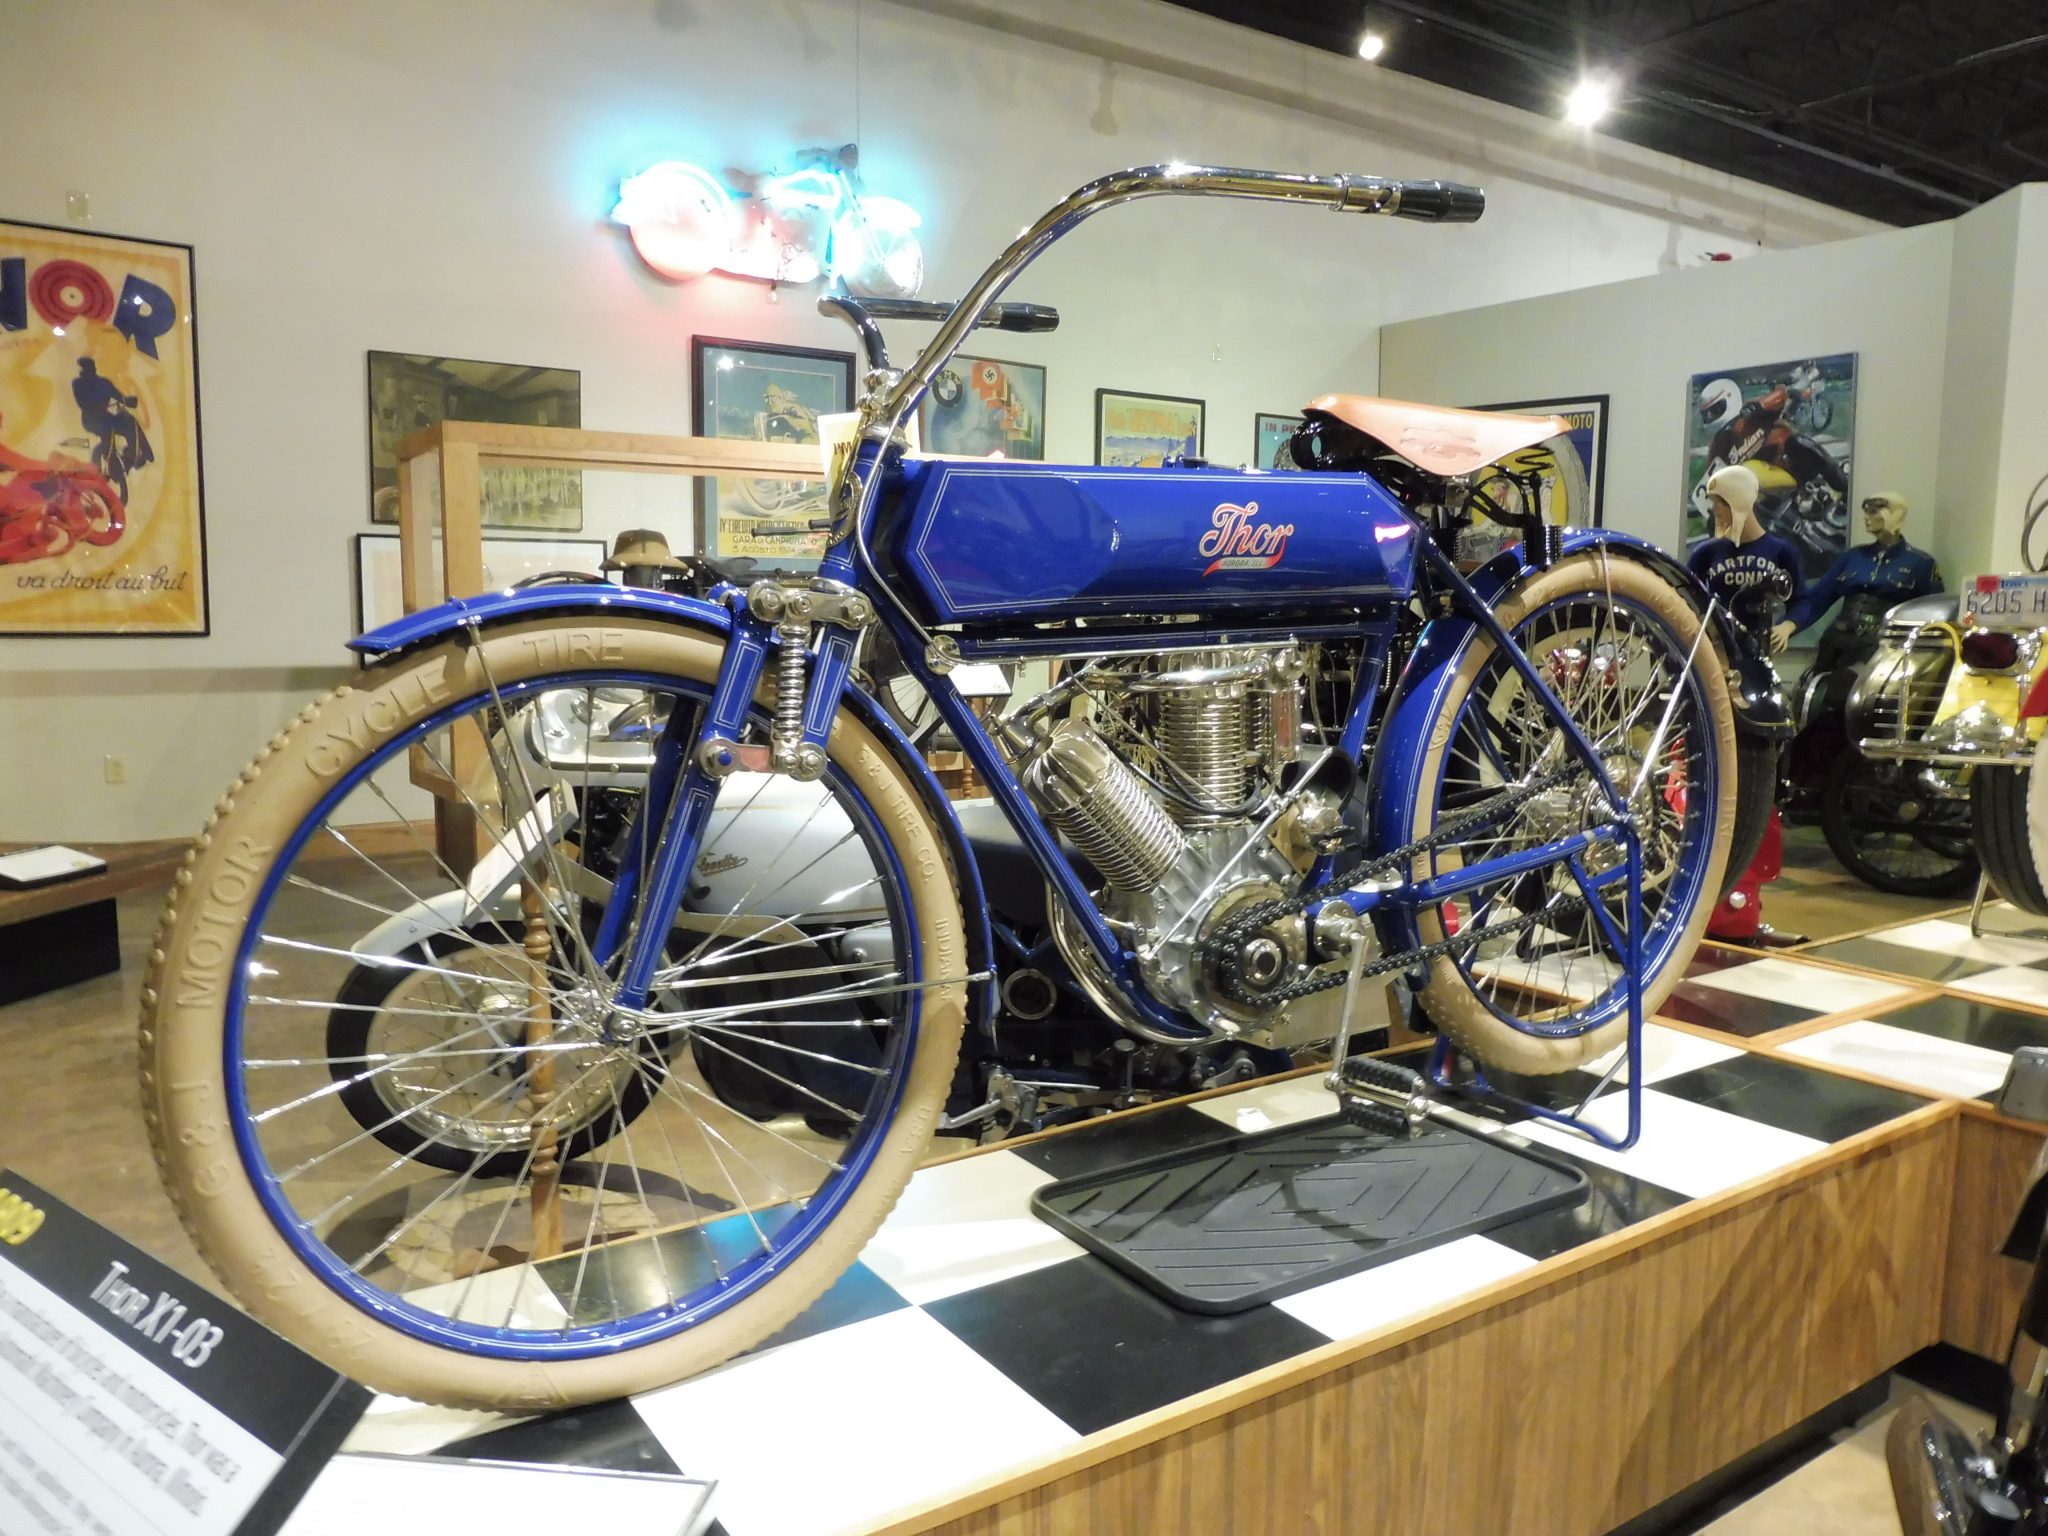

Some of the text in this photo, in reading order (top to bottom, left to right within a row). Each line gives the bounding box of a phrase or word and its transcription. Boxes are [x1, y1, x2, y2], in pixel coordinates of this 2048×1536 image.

[1728, 427, 1765, 465] Indian
[1199, 501, 1294, 558] Thor
[742, 545, 776, 554] AGOSTO
[17, 564, 188, 591] va droit au but
[177, 835, 273, 1010] MOTOR
[305, 654, 451, 778] CYCLE
[522, 631, 625, 669] TIRE
